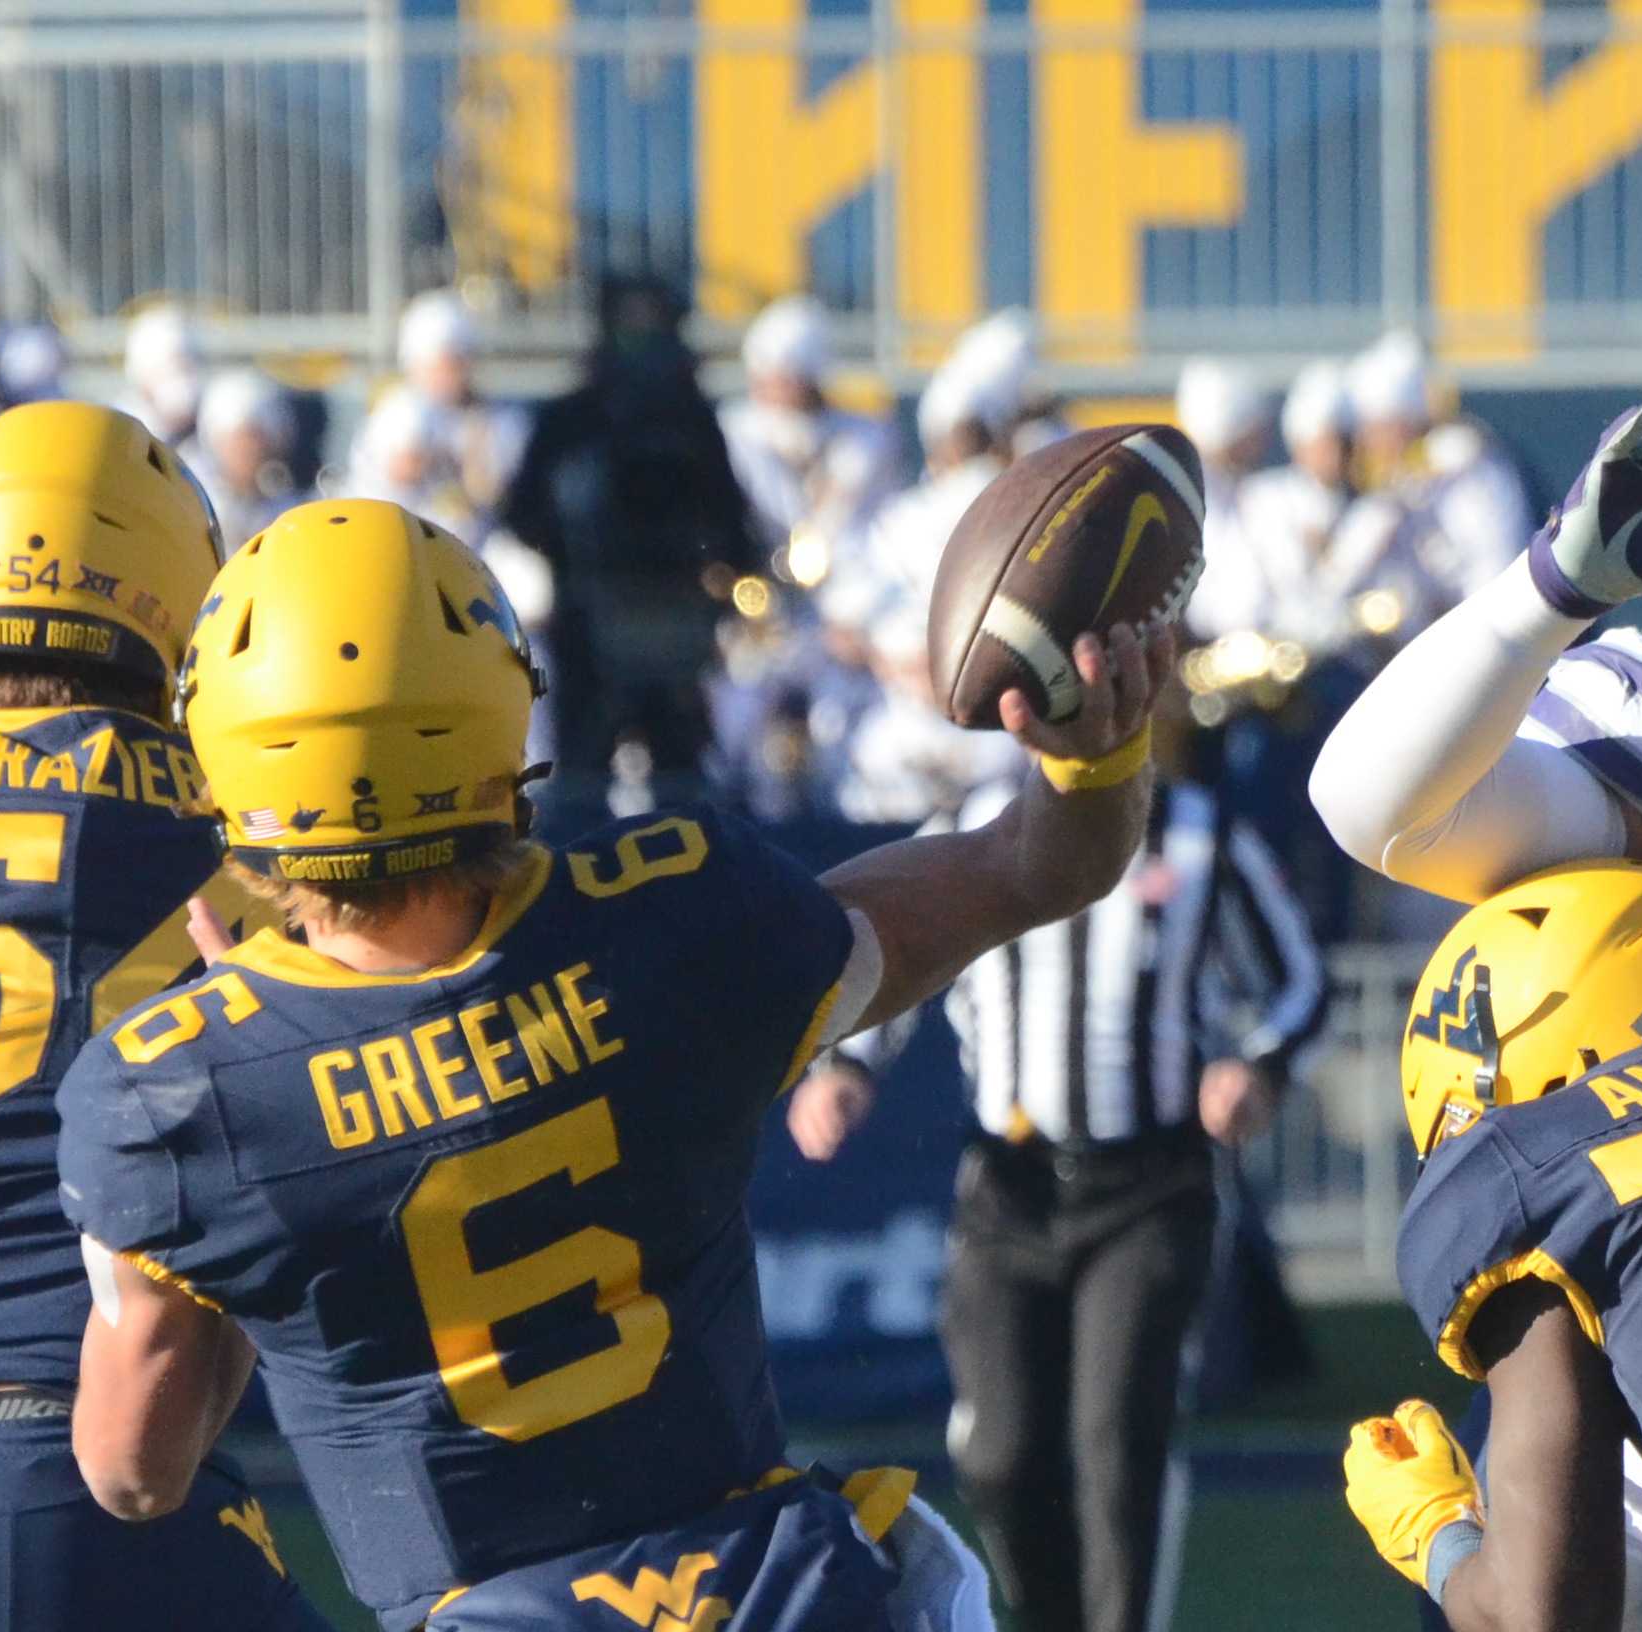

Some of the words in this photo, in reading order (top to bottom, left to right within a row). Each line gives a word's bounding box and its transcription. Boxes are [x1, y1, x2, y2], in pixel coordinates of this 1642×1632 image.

[8, 556, 61, 596] 54
[45, 619, 112, 655] ROADS
[352, 796, 383, 833] 6
[386, 839, 455, 876] ROADS
[308, 962, 625, 1150] GREENE
[400, 1096, 671, 1444] 6
